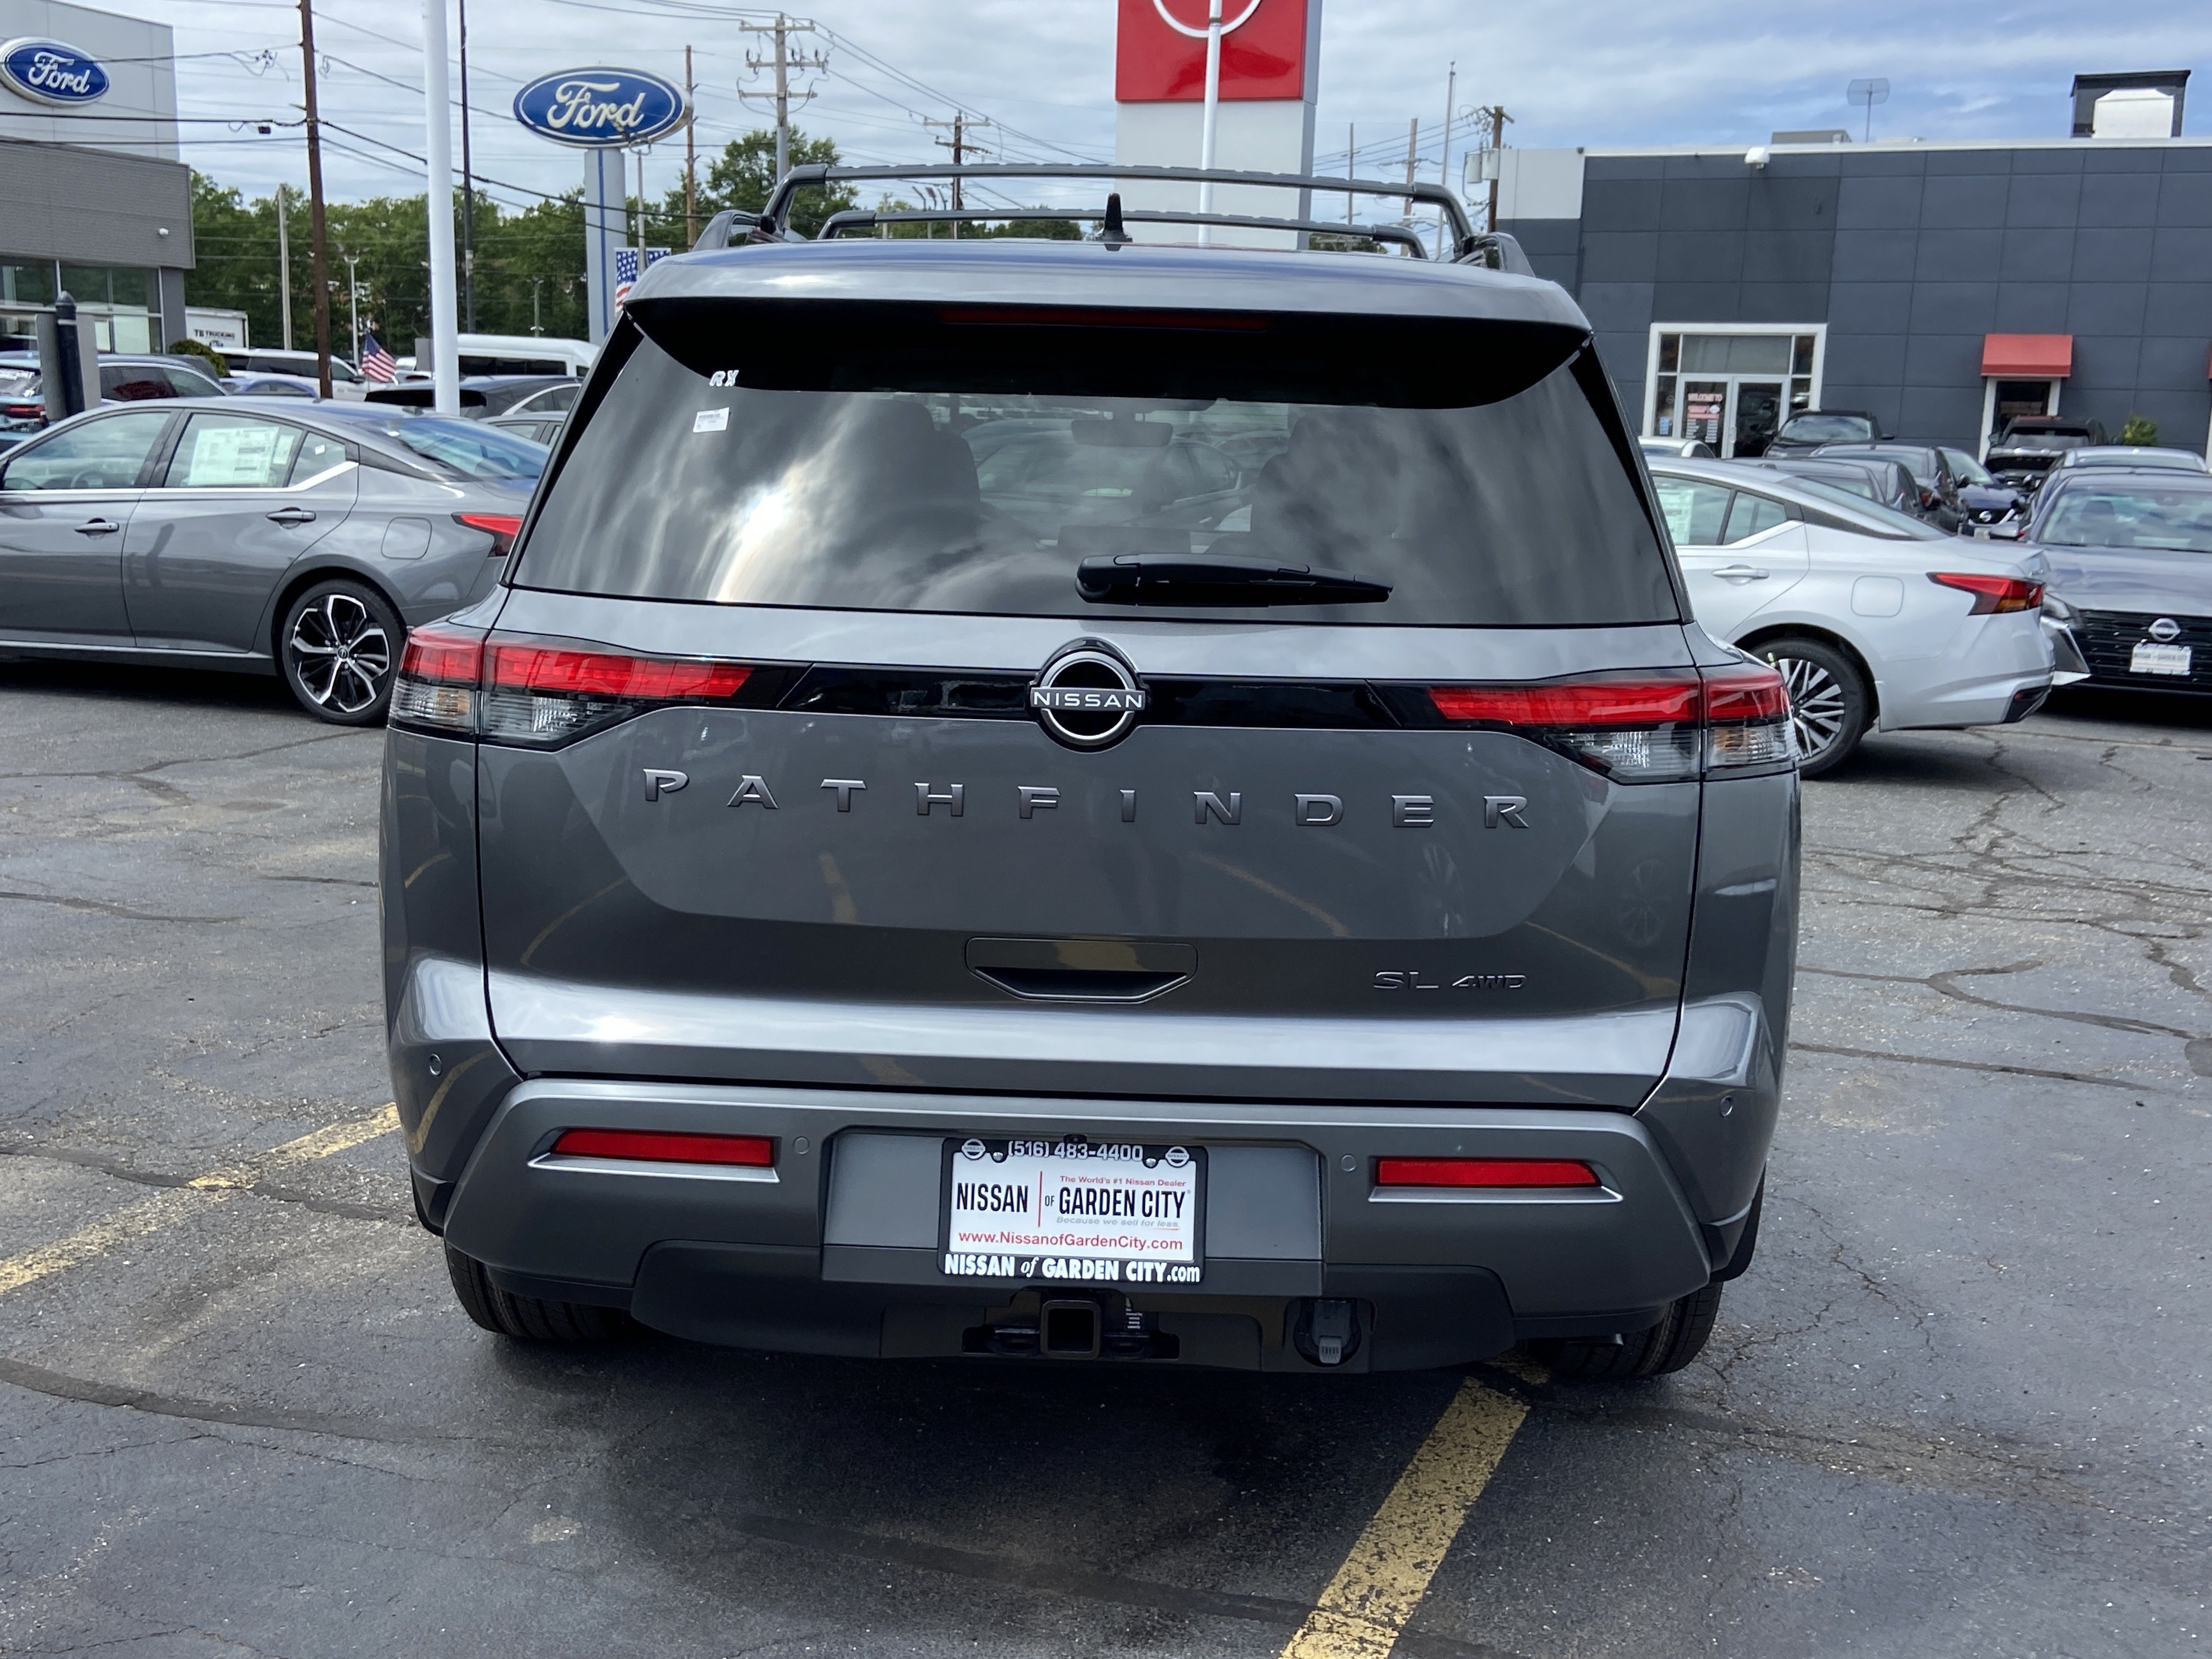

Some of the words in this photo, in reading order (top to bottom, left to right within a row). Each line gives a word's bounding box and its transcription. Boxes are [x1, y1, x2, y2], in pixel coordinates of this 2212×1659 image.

[29, 52, 91, 94] Ford
[547, 81, 646, 128] Ford
[709, 370, 740, 387] RX
[1033, 691, 1142, 708] NISSAN
[642, 768, 1530, 828] PATHFINDER
[1373, 971, 1440, 989] SL
[1452, 974, 1526, 988] 4WD
[1008, 1141, 1050, 1158] (516)
[1053, 1142, 1144, 1162] 483-4400
[1078, 1176, 1110, 1184] World's
[957, 1182, 1029, 1212] NISSAN
[1045, 1195, 1055, 1206] OF
[1059, 1187, 1136, 1216] GARDEN
[1142, 1189, 1186, 1218] CITY
[1057, 1216, 1100, 1225] Because
[1141, 1219, 1154, 1227] for
[1157, 1220, 1180, 1228] less.
[958, 1231, 1183, 1251] www.NissanofGardenCity.com
[944, 1253, 1015, 1277] NISSAN
[1020, 1256, 1040, 1278] of
[1042, 1257, 1120, 1280] GARDEN
[1126, 1260, 1200, 1283] CITY.com
